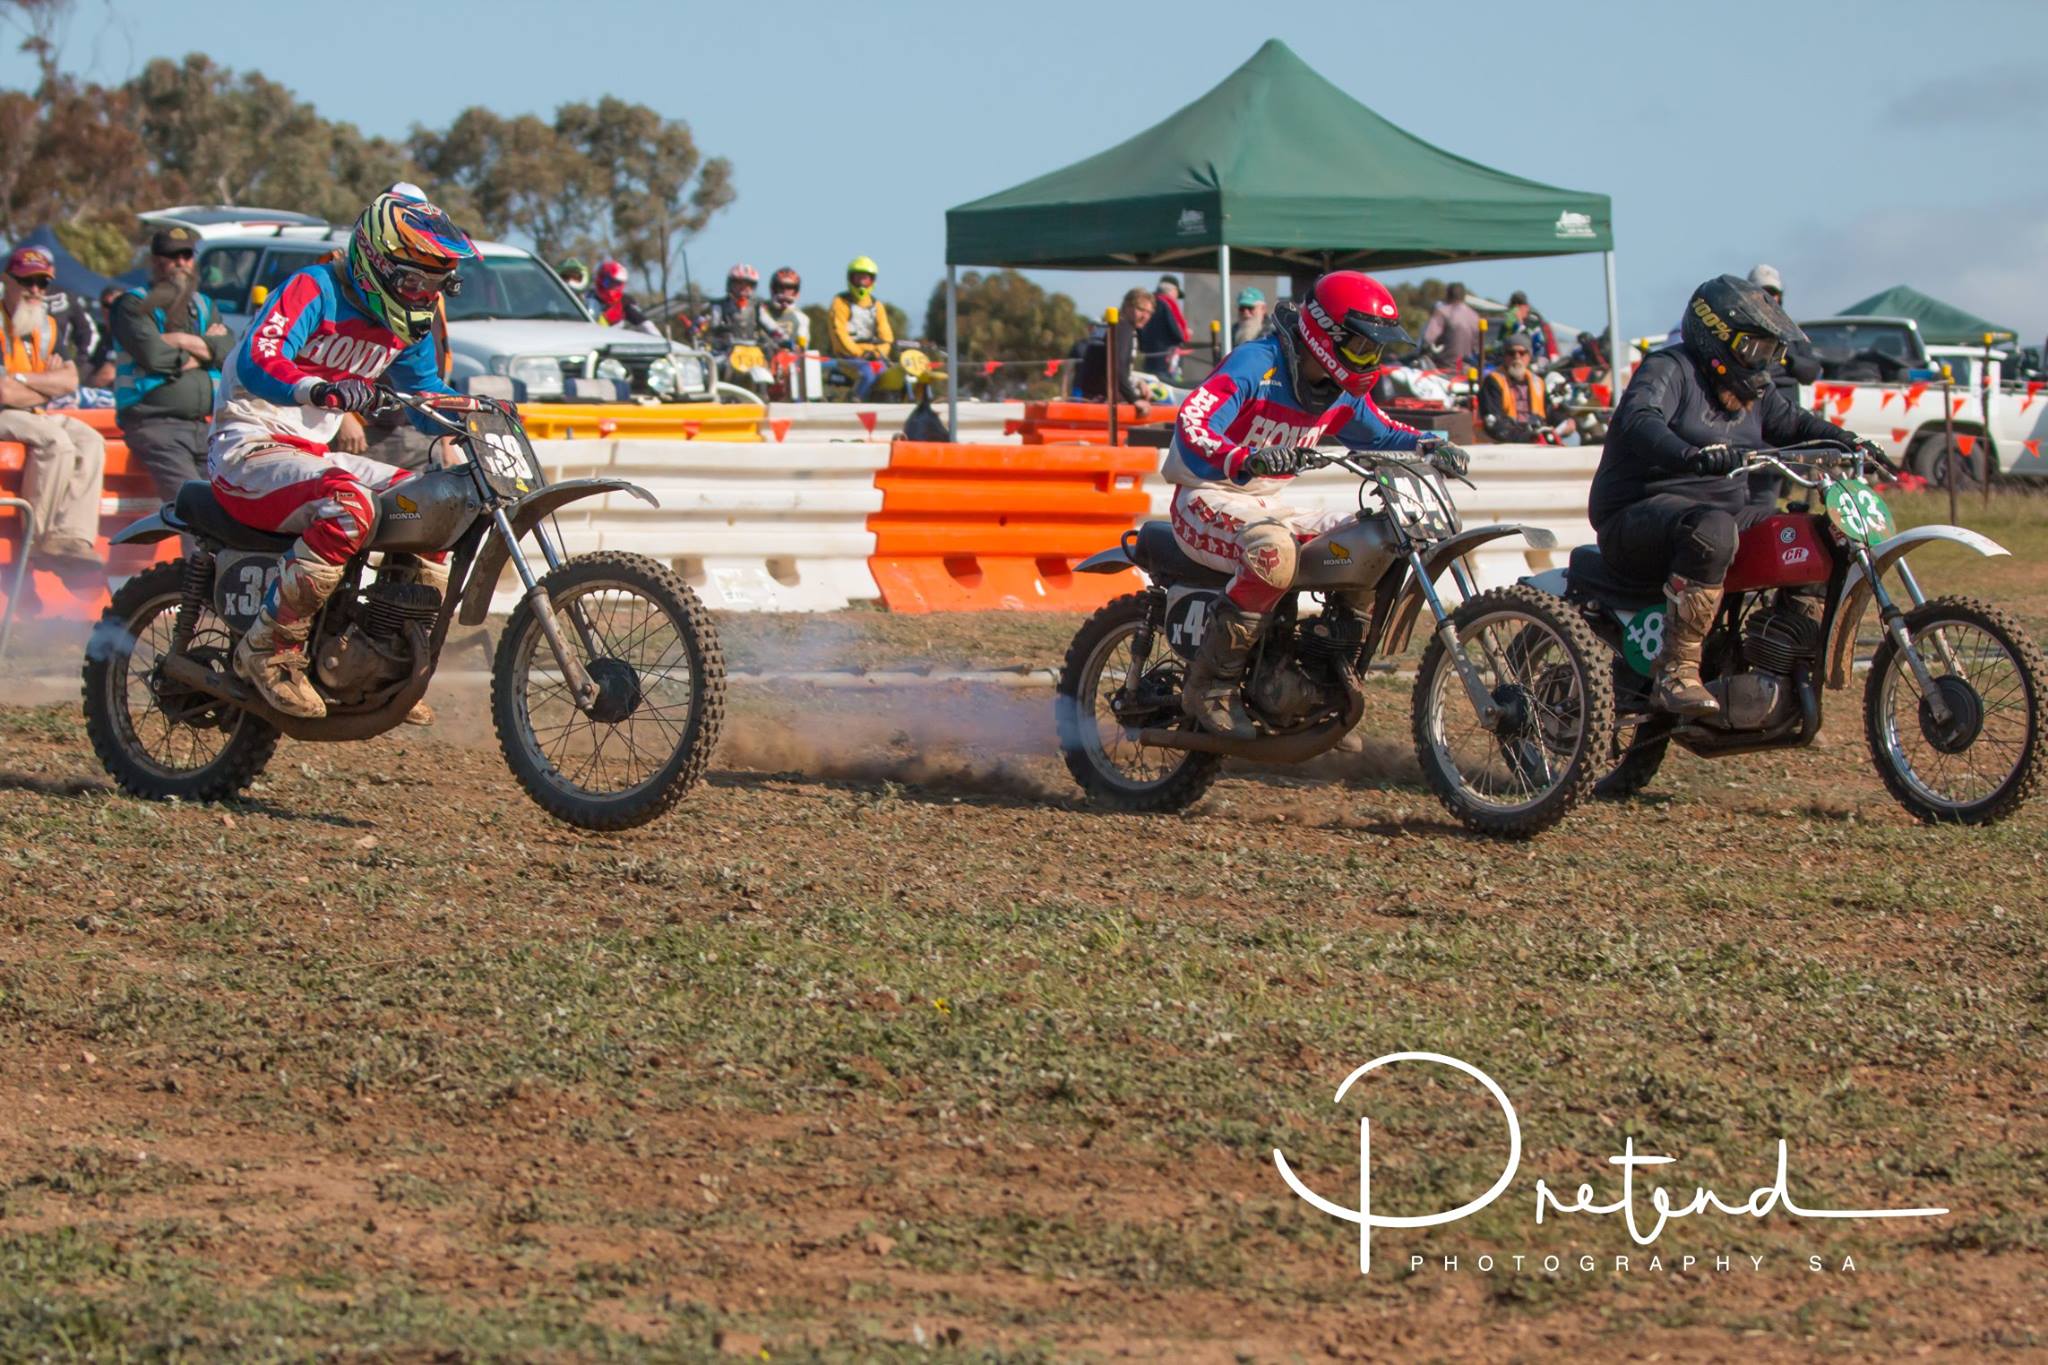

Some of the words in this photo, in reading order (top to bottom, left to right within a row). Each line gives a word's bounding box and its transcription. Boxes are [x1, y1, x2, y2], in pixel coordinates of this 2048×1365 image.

[1308, 299, 1348, 342] 100%
[1693, 297, 1732, 341] 100%
[1308, 336, 1337, 369] MOTO
[389, 511, 422, 520] HONDA
[1323, 558, 1352, 566] HONDA
[1171, 600, 1209, 647] x4
